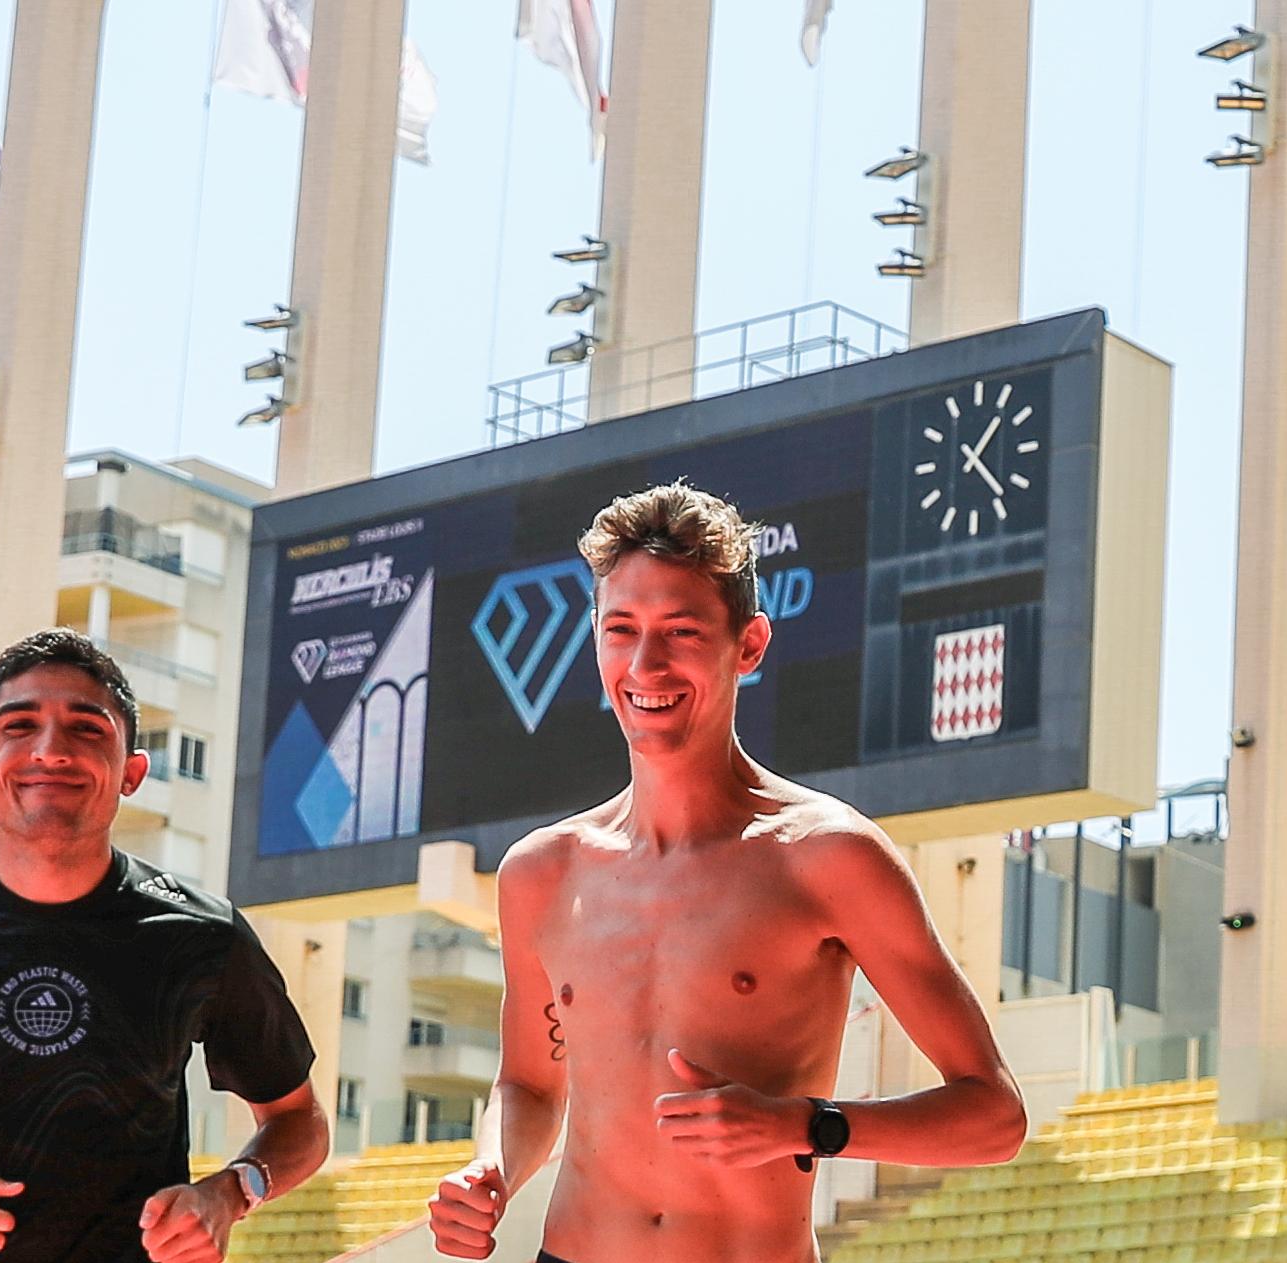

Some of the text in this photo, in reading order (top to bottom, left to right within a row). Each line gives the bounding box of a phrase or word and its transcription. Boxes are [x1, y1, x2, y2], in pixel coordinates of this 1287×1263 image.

[755, 522, 799, 556] DA
[18, 966, 59, 982] PLASTIC
[61, 971, 88, 997] WASTE
[29, 1040, 69, 1056] PLASTIC
